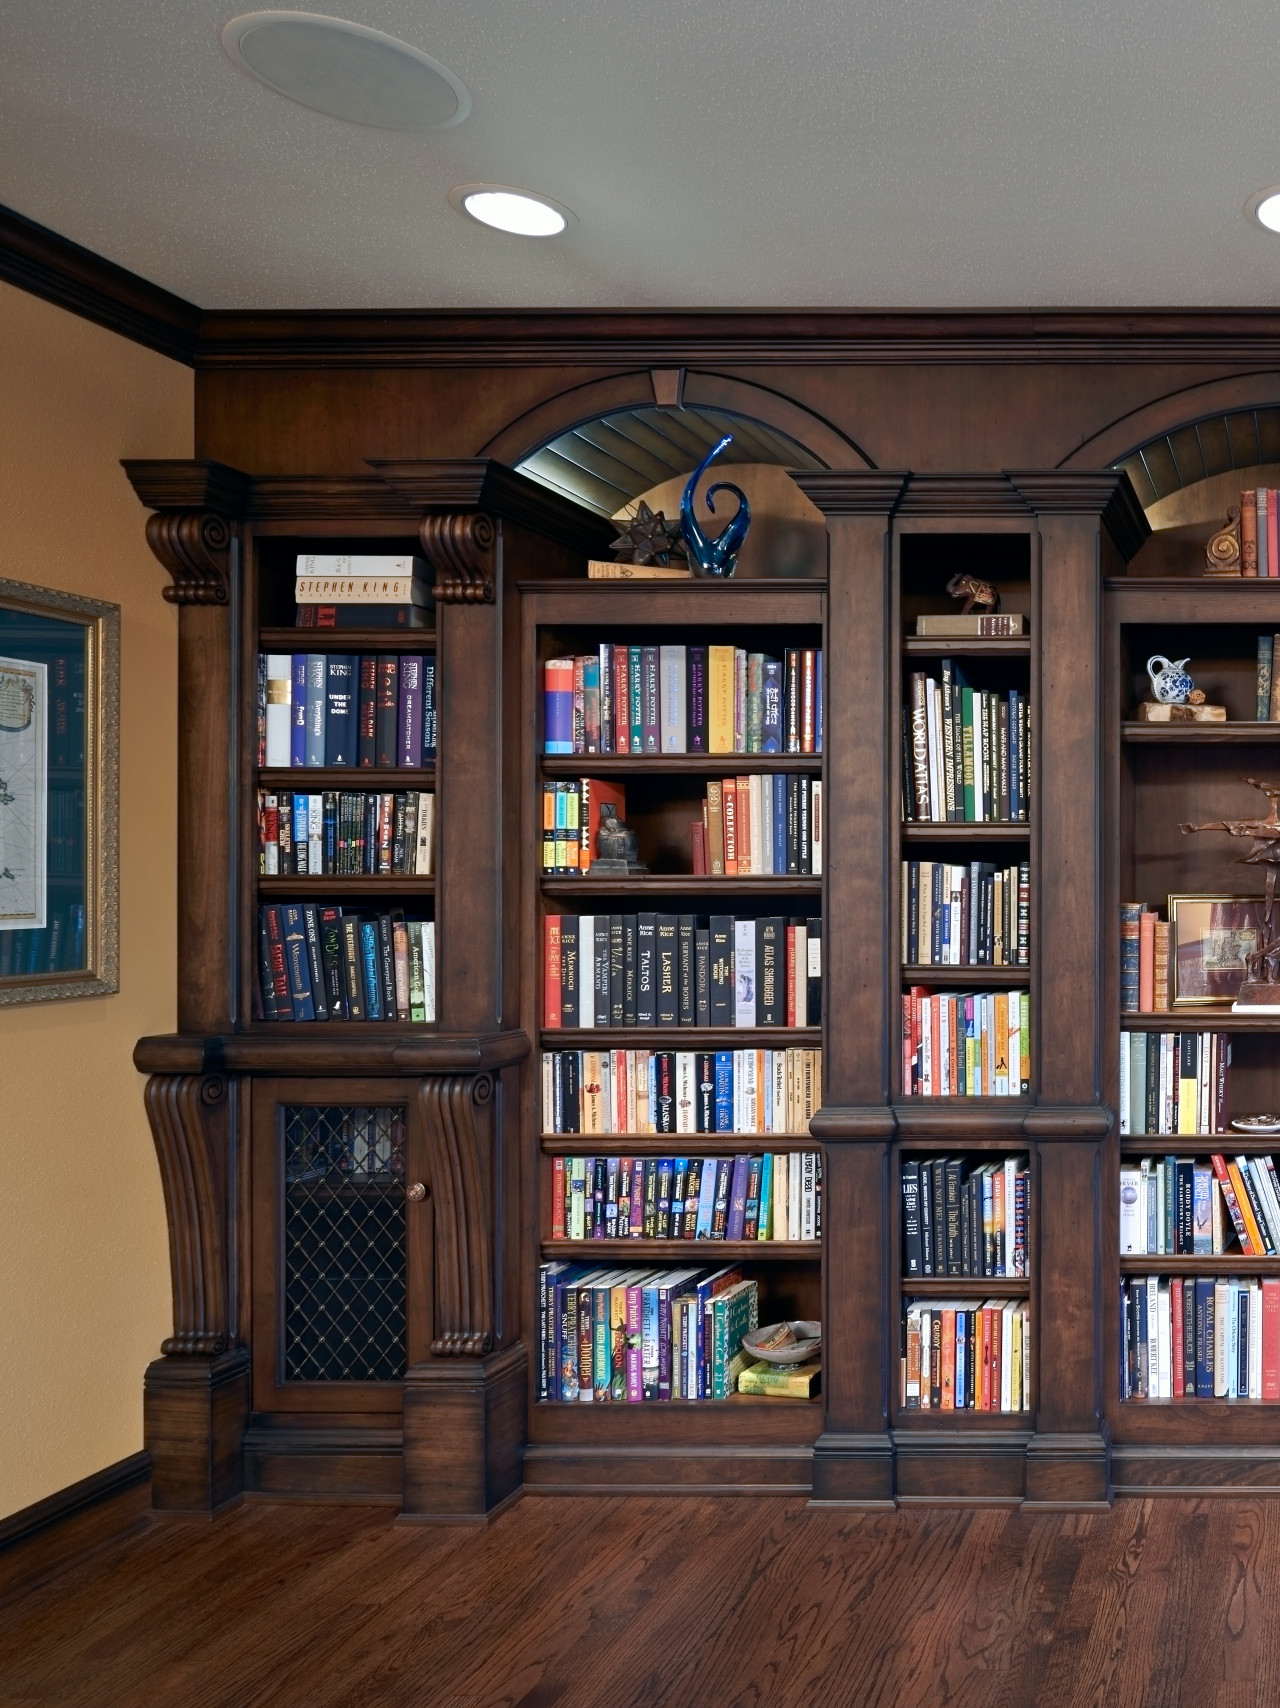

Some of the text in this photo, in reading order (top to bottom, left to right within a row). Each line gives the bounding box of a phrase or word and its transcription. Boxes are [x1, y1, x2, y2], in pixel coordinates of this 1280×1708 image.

[300, 582, 399, 592] STEPHEN KING
[404, 663, 412, 690] KING
[424, 666, 433, 747] Different Seasons
[913, 708, 928, 804] WORLD ATLAS
[944, 719, 955, 811] WESTERN IMPRESSIONS
[963, 726, 974, 785] TILLAMOOK
[270, 944, 287, 996] FAERIE TALE
[382, 957, 392, 983] Graveyard
[413, 946, 422, 978] American
[640, 951, 650, 991] TALTOS
[662, 952, 672, 993] LASHER
[763, 945, 774, 1006] ATLAS SHRUGGED
[688, 1172, 696, 1196] PRATCHETT
[903, 1184, 918, 1193] LIES
[935, 1168, 943, 1186] WHY
[948, 1181, 959, 1203] Franken
[937, 1225, 943, 1233] AL
[948, 1210, 959, 1221] The
[948, 1221, 959, 1237] Truth
[628, 1291, 638, 1304] Terry
[567, 1292, 577, 1358] TERRY PRATCHETT
[580, 1344, 592, 1377] Dodger
[597, 1345, 605, 1379] ACADEMICALS
